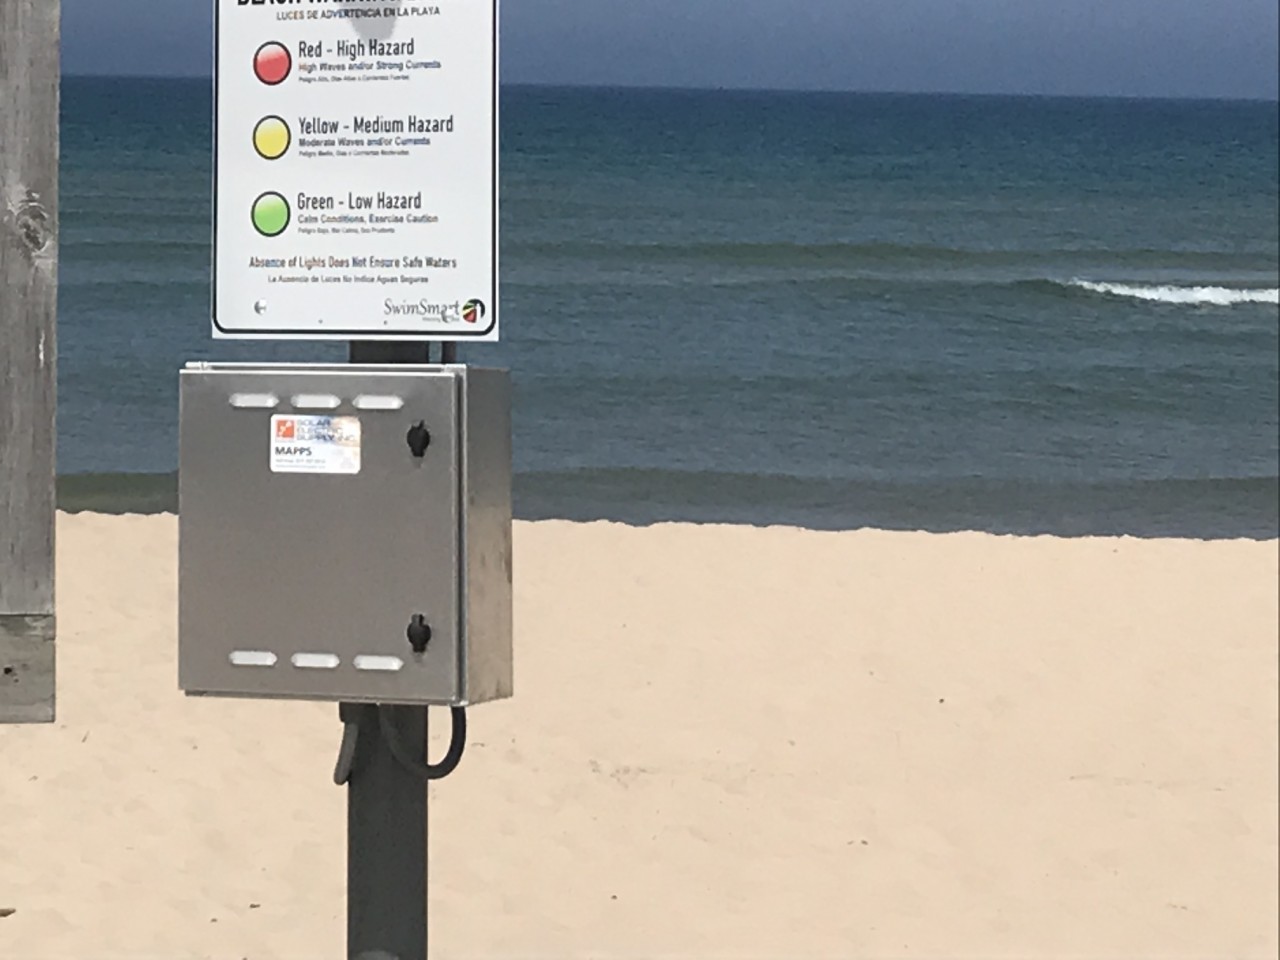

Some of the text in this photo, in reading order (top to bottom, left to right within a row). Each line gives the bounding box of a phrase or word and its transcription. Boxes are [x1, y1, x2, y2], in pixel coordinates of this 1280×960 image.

[298, 40, 322, 58] Red
[336, 38, 365, 60] High
[367, 37, 414, 56] Hazard
[298, 116, 339, 135] Yellow
[353, 115, 404, 134] Medium
[407, 114, 453, 133] Hazard
[297, 191, 334, 210] Green
[348, 191, 373, 210] Low
[376, 191, 422, 209] Hazard
[248, 255, 457, 271] Absence of Lights Does Not Ensure Safe Waters
[383, 297, 460, 315] SwimSmart
[274, 446, 312, 456] MAPPS
